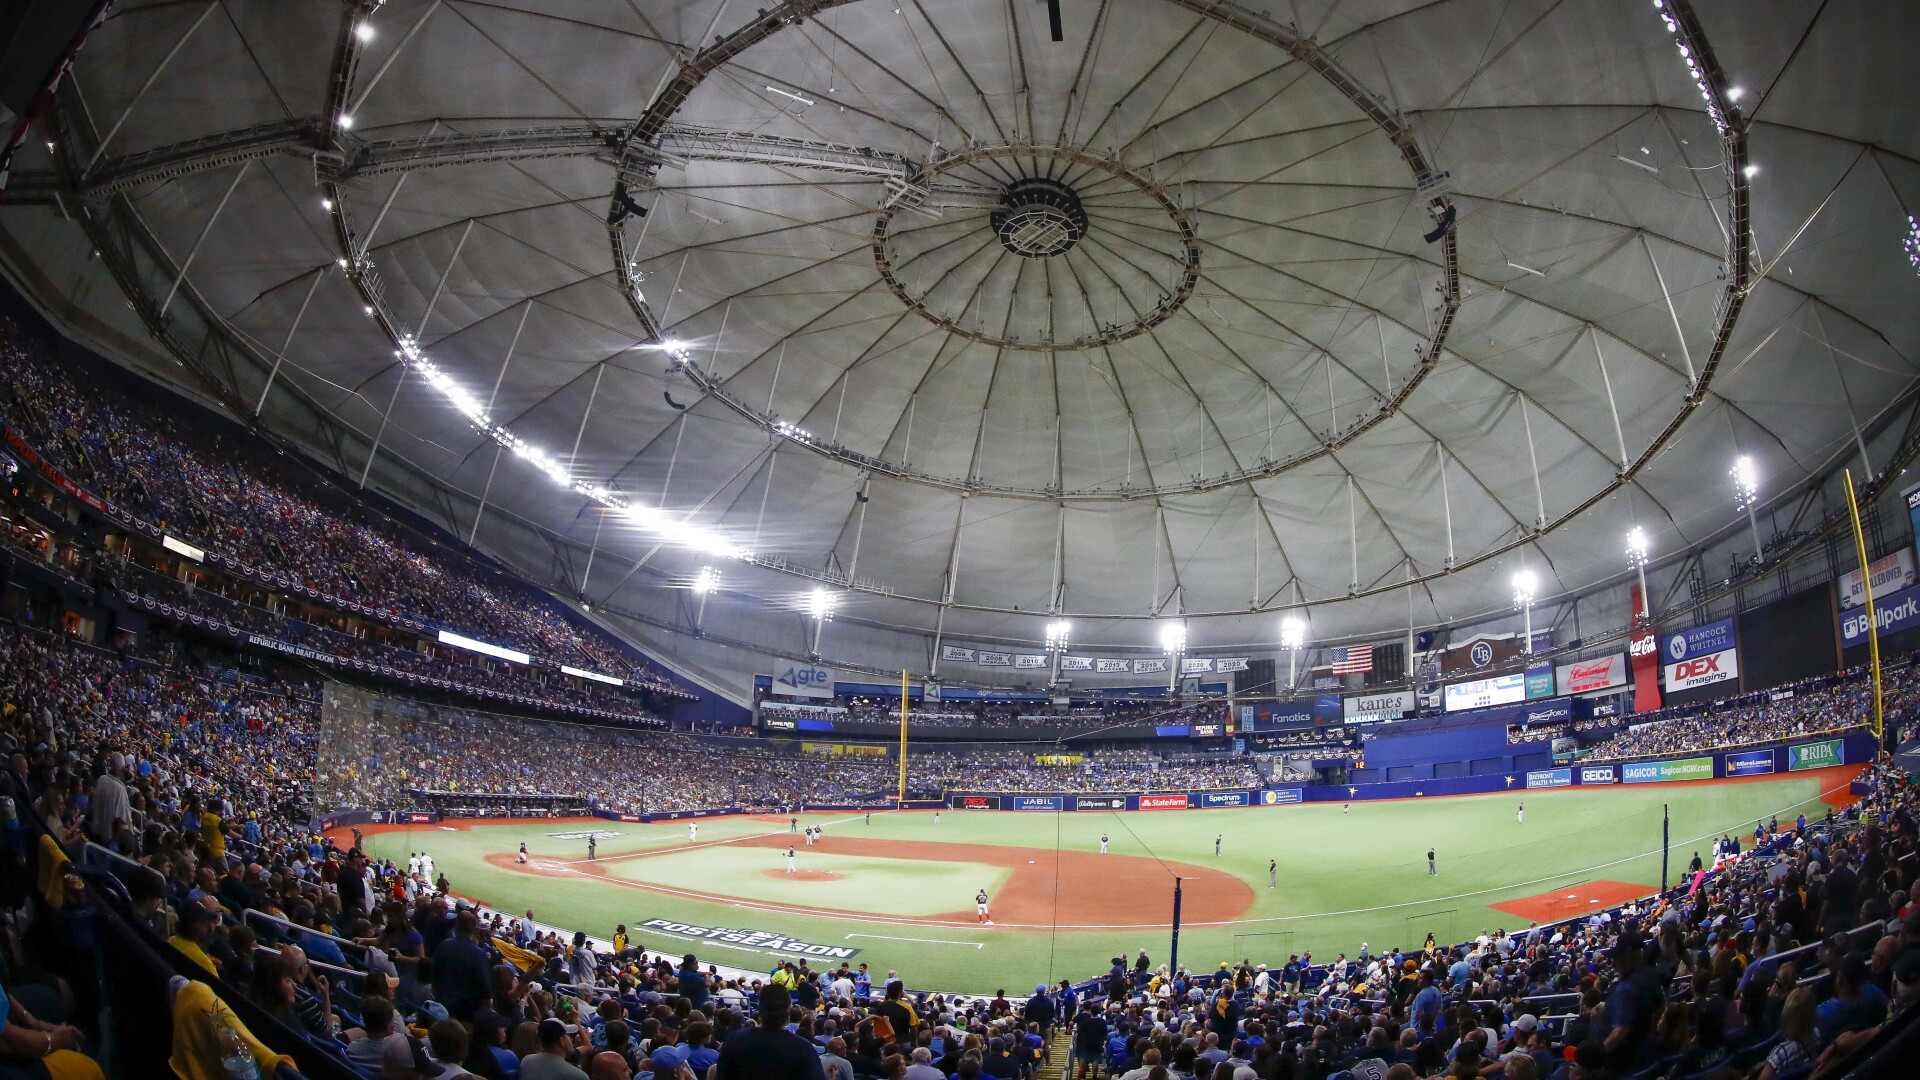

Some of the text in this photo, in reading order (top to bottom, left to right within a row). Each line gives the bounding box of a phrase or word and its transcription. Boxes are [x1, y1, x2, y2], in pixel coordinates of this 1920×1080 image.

[1688, 625, 1726, 643] HANCOCK
[249, 635, 334, 664] REPUBLIC BANK DRAFT ROOM
[1689, 635, 1727, 652] WHITNEY
[1675, 654, 1721, 681] DEX
[797, 668, 827, 684] gte
[1686, 671, 1727, 686] imaging
[1356, 696, 1402, 712] kanes
[1272, 712, 1311, 723] Fanatics
[1809, 744, 1833, 760] RIPA
[1582, 769, 1612, 781] GEICO
[1625, 764, 1711, 779] SAGICOR SagicorNOW.com
[963, 797, 988, 805] DEX
[1208, 794, 1240, 802] Spectrum
[643, 918, 855, 959] POSTSEASON
[1365, 1065, 1383, 1080] 5
